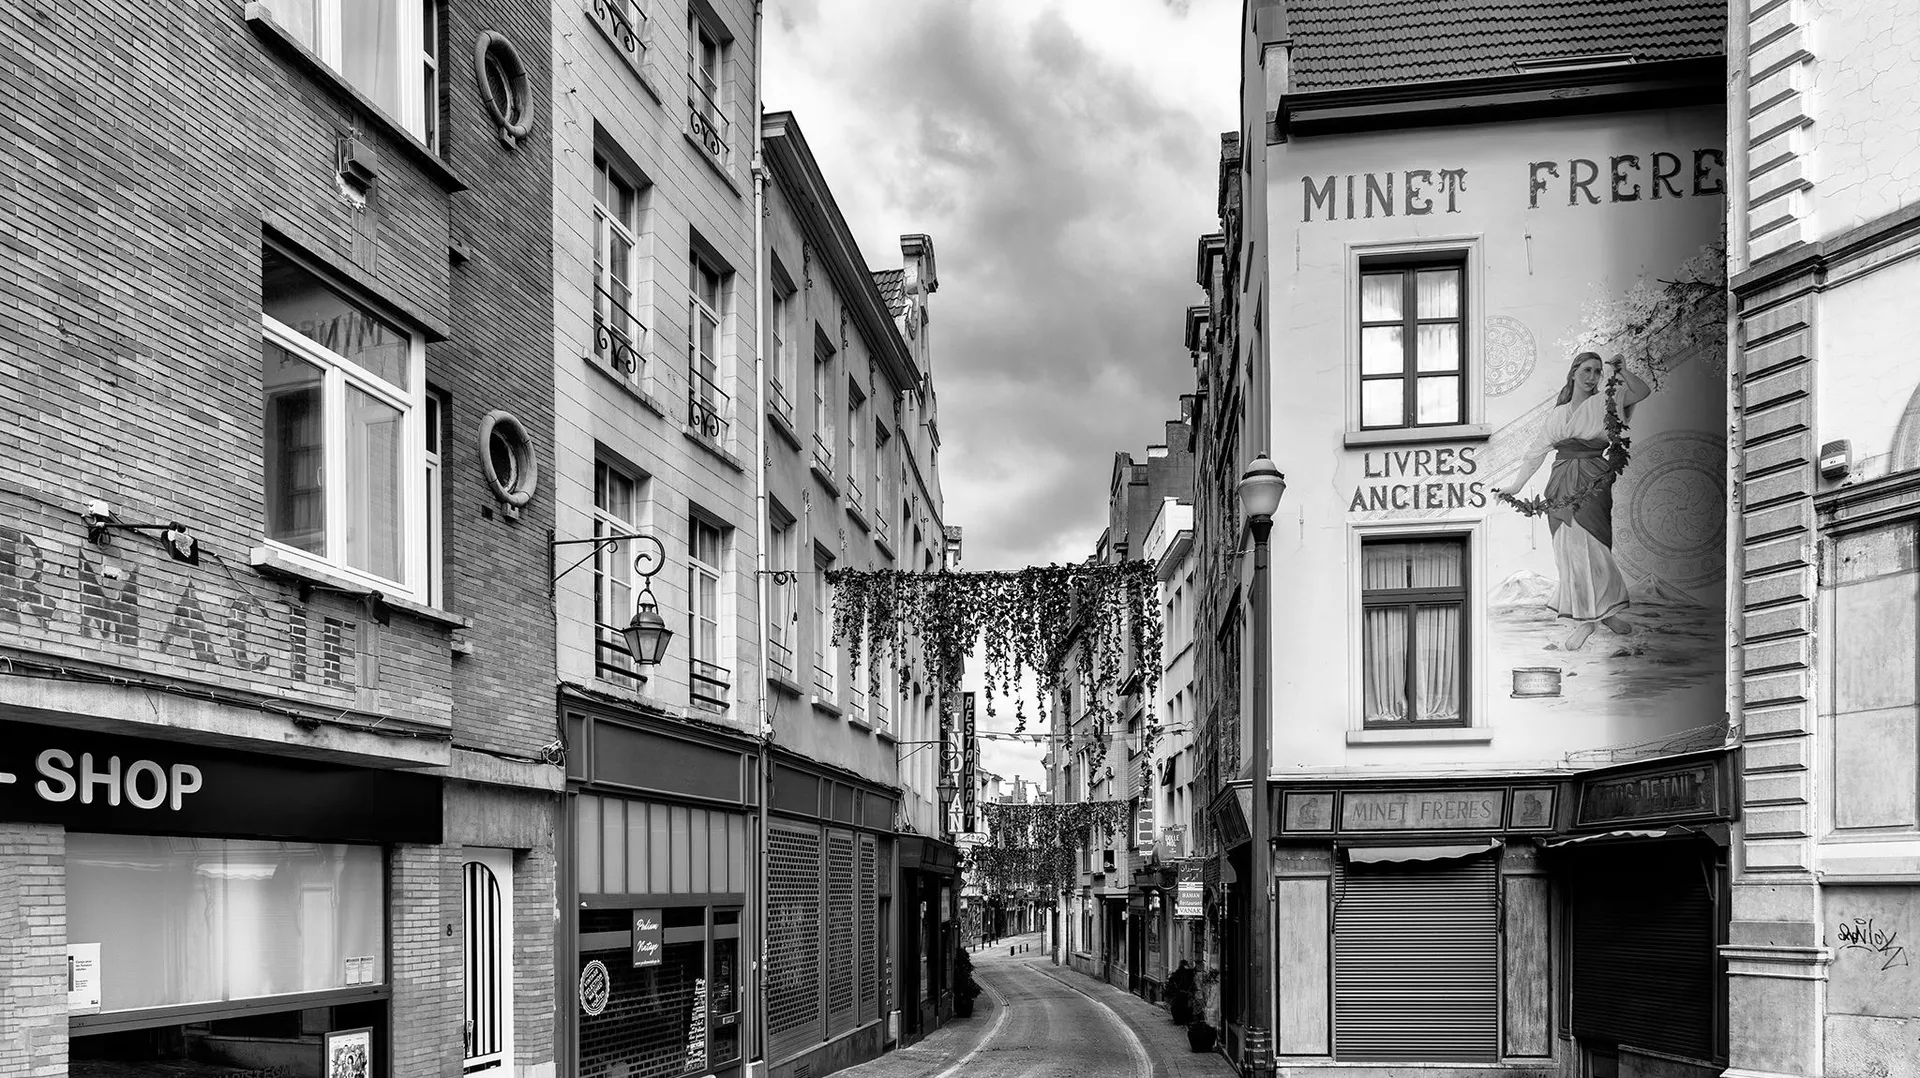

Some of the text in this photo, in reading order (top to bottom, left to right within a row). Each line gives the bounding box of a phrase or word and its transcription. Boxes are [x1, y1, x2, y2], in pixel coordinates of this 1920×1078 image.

[1301, 148, 1727, 222] MINET FRERE
[1363, 446, 1477, 478] LIVRES
[1348, 482, 1487, 512] ANCIENS
[35, 749, 203, 811] SHOP
[949, 712, 965, 832] INDIAN
[965, 696, 974, 828] RESTAURANT
[1352, 800, 1493, 822] MINET FRERES
[447, 923, 453, 937] 8
